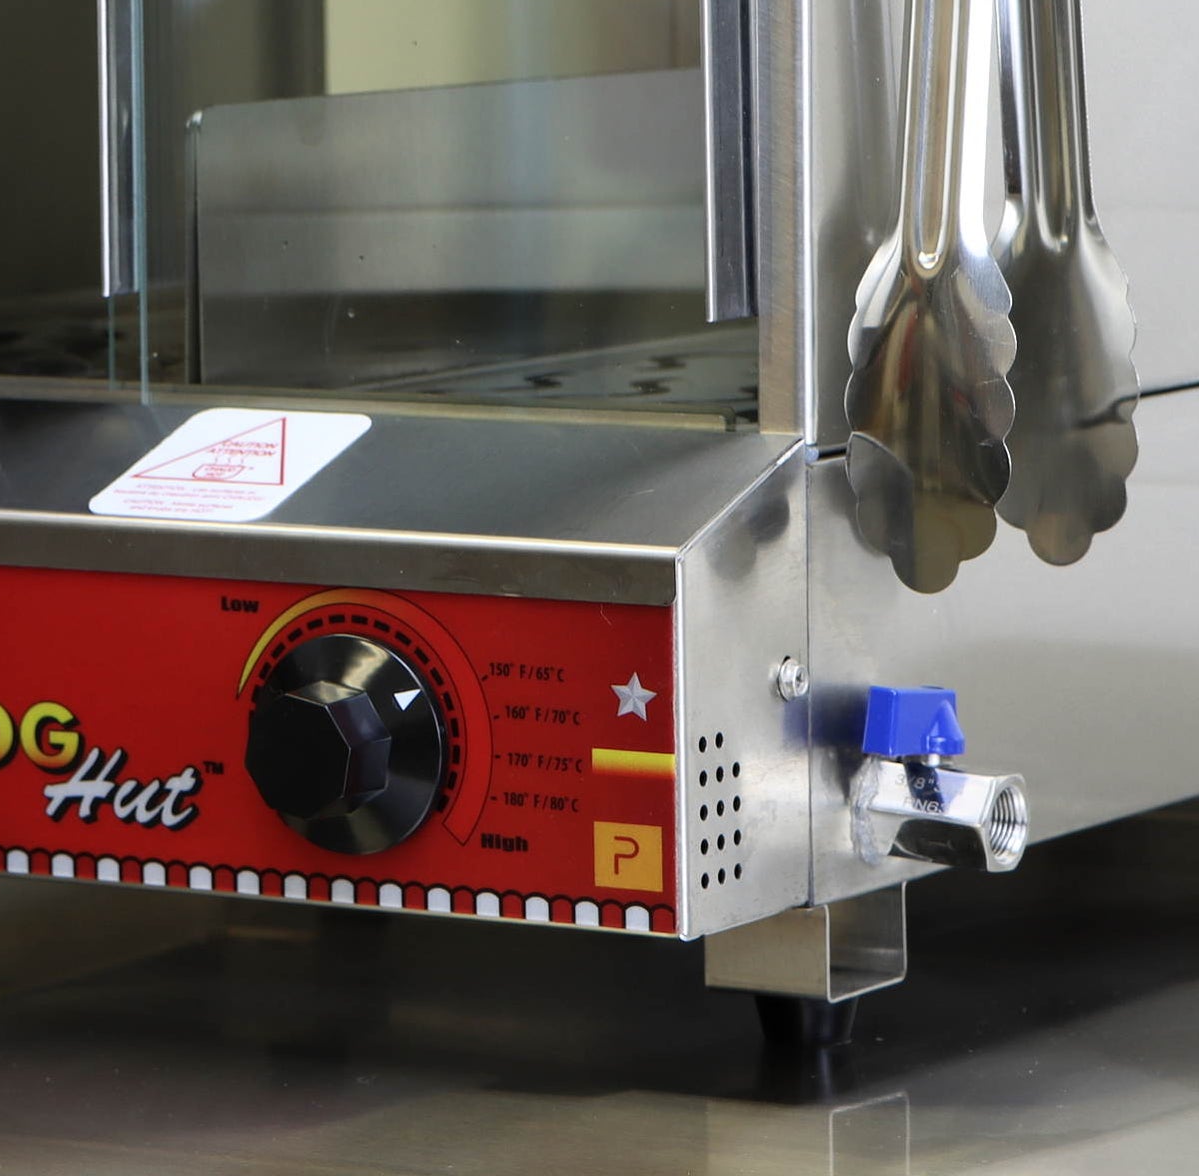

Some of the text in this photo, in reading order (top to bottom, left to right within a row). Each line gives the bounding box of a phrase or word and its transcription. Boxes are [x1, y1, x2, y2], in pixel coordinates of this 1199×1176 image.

[221, 596, 259, 613] Low
[43, 747, 204, 830] Hut
[481, 832, 529, 852] High
